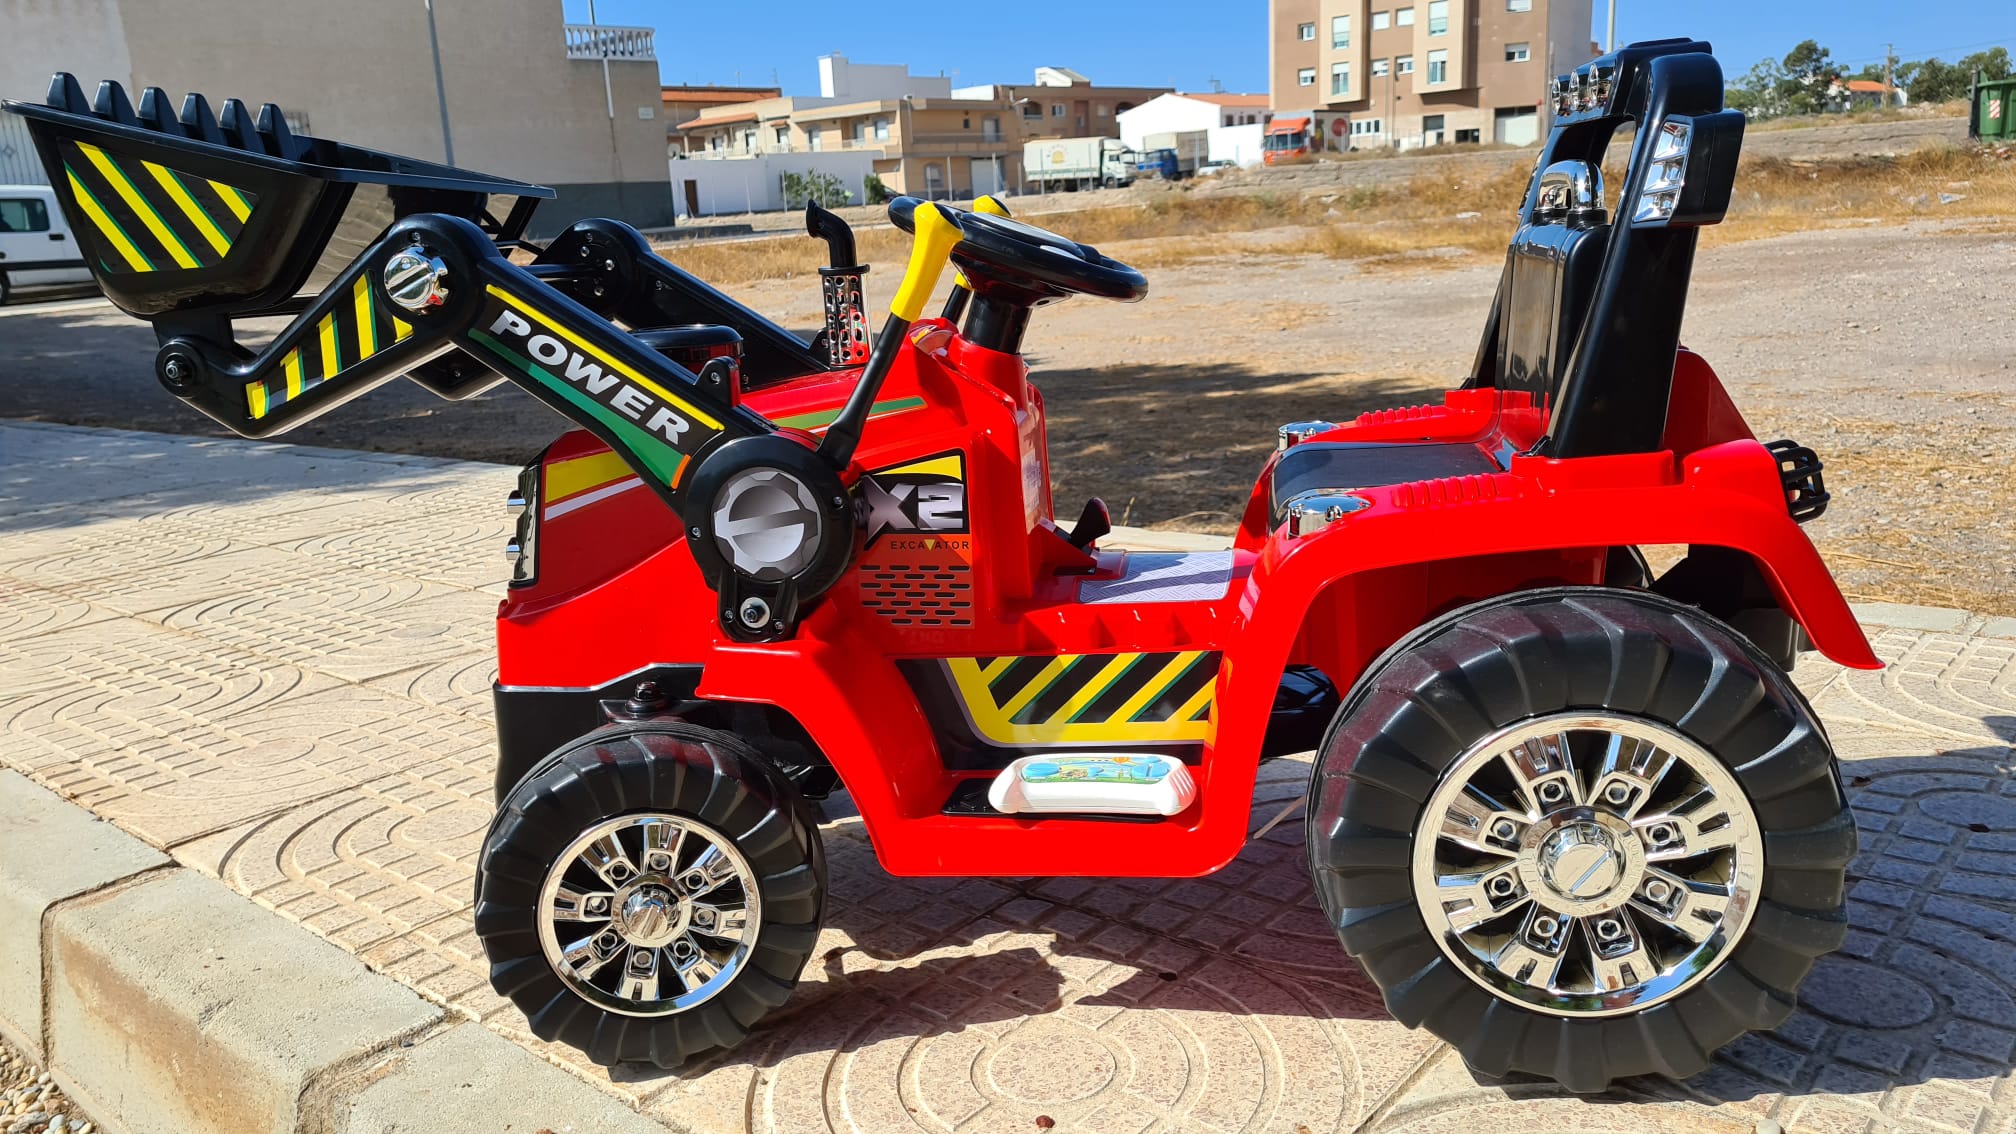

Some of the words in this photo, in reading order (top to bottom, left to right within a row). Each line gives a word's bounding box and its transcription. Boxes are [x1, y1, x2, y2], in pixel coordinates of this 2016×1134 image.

[489, 309, 690, 445] POWER
[862, 474, 964, 539] X2
[890, 539, 970, 551] EXCAVATOR
